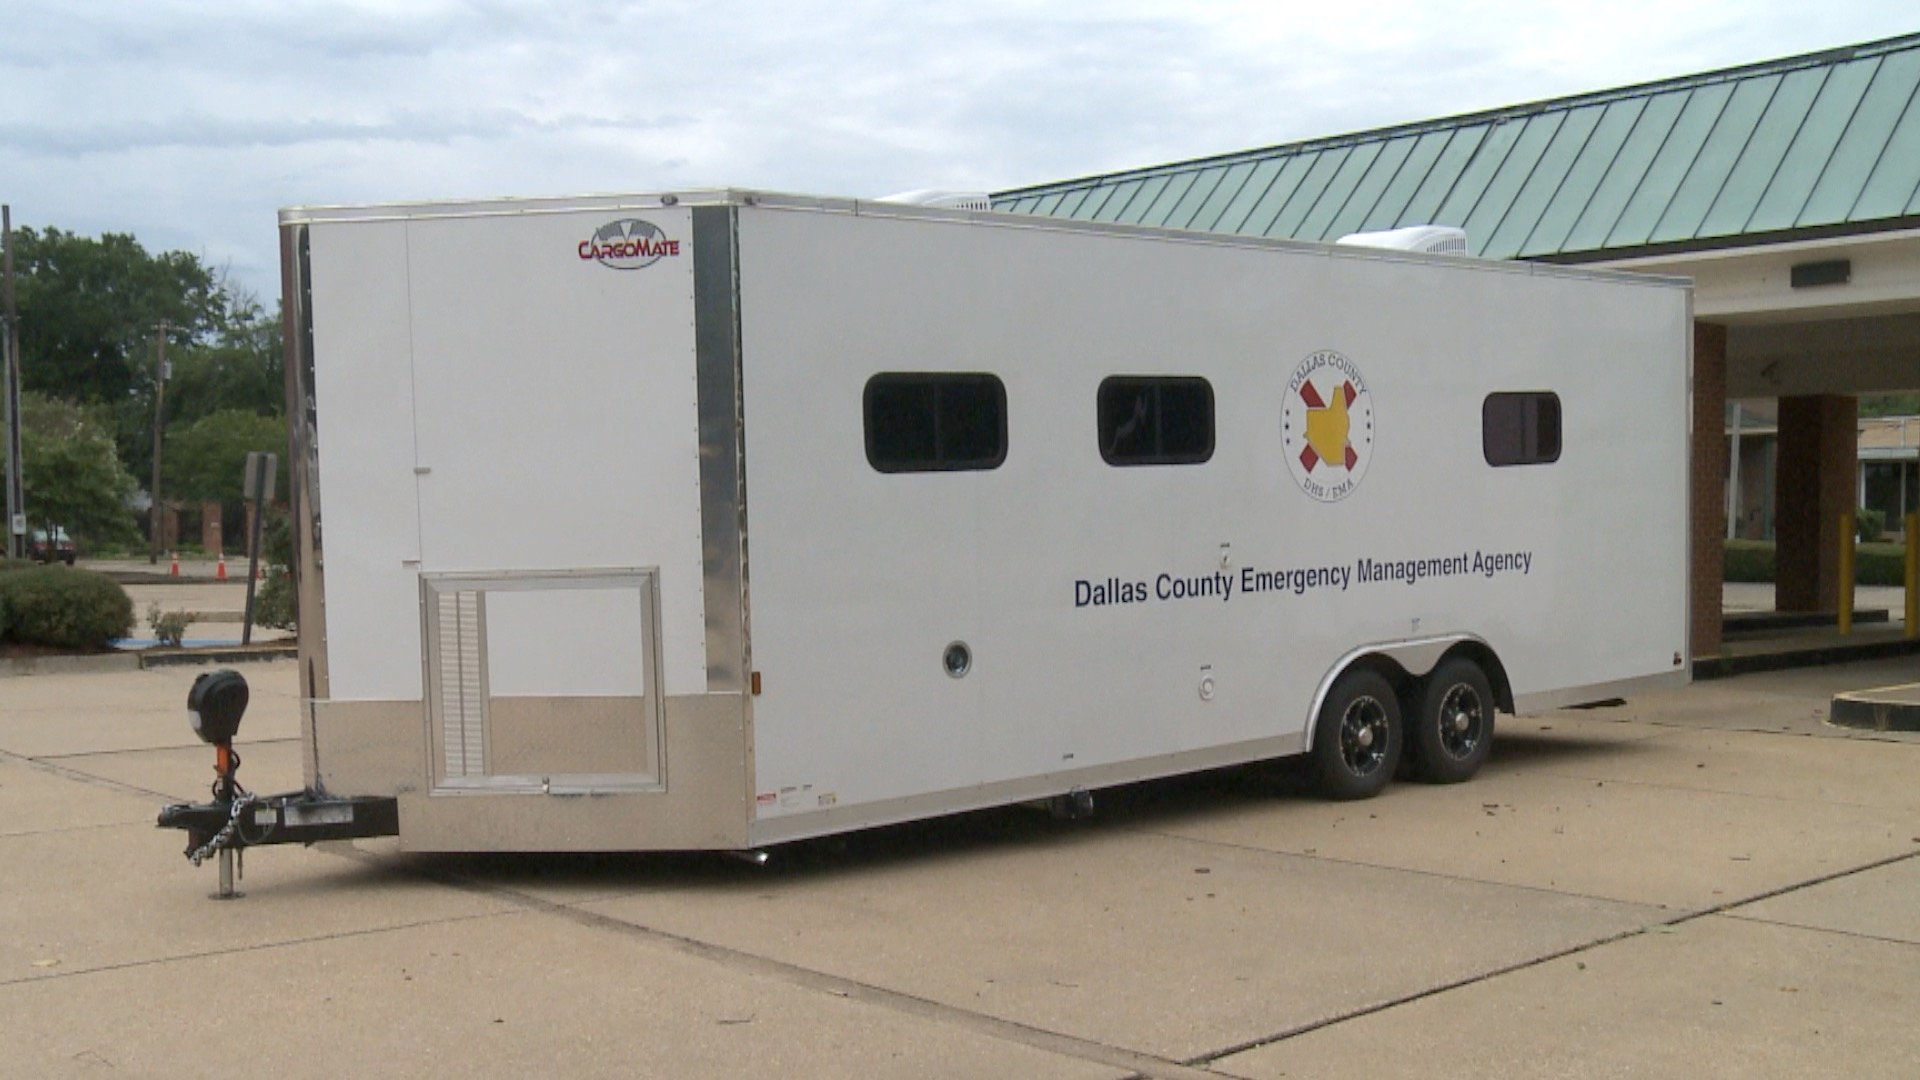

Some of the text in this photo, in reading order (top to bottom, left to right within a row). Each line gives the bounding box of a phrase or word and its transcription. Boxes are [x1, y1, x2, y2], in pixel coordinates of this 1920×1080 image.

[1290, 353, 1367, 394] DALLAS COUNTY
[1303, 477, 1324, 497] DHS
[1332, 477, 1354, 499] EMA
[1075, 549, 1532, 608] Dallas County Emergency Management Agency
